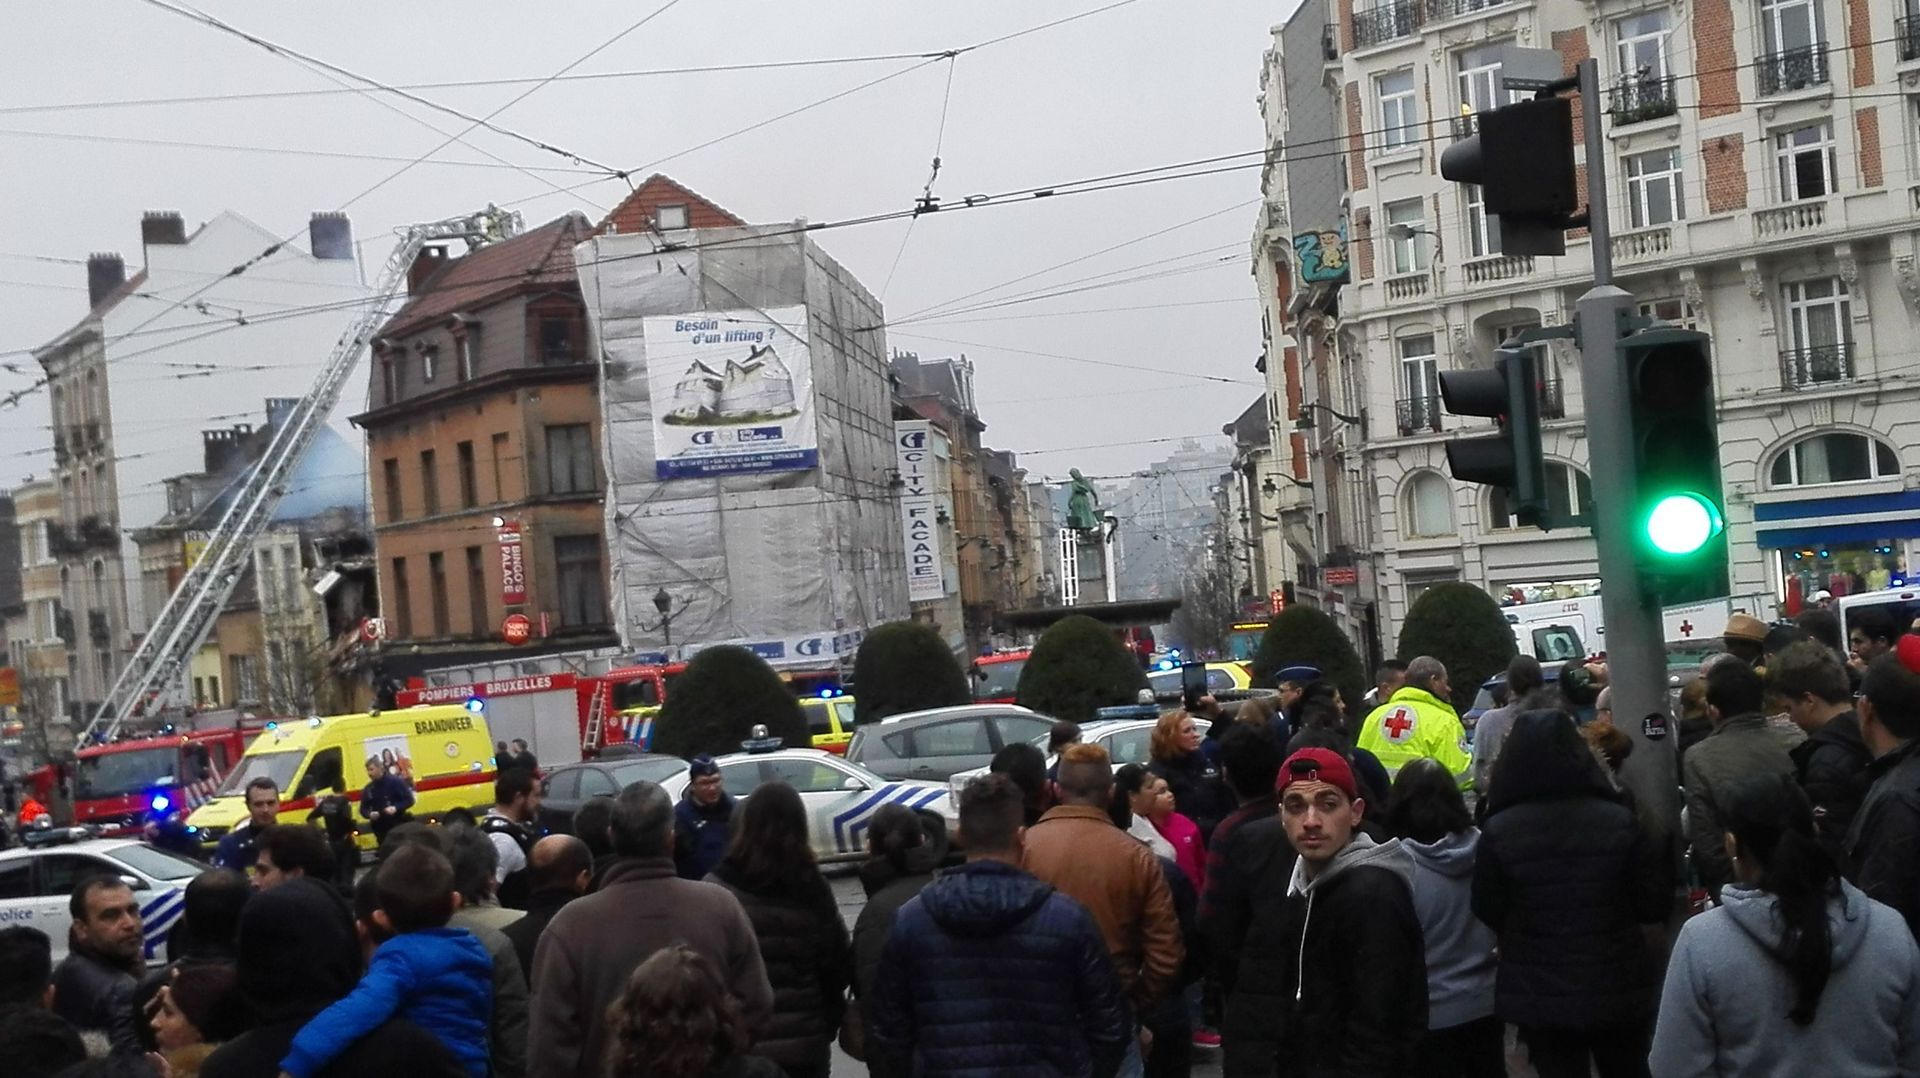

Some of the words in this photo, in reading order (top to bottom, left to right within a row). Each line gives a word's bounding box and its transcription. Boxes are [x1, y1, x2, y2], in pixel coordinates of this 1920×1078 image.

[674, 319, 719, 332] Besoin
[692, 331, 721, 345] d'un
[725, 329, 764, 344] lifting
[768, 328, 776, 340] ?
[904, 452, 925, 497] CITY
[909, 507, 933, 576] FACADE
[501, 546, 514, 593] PALACE
[511, 545, 525, 593] BINGO'S
[418, 685, 475, 702] POMPIERS
[486, 676, 552, 695] BRUXELLES
[414, 716, 474, 735] BRANDWEER
[0, 907, 33, 921] olice
